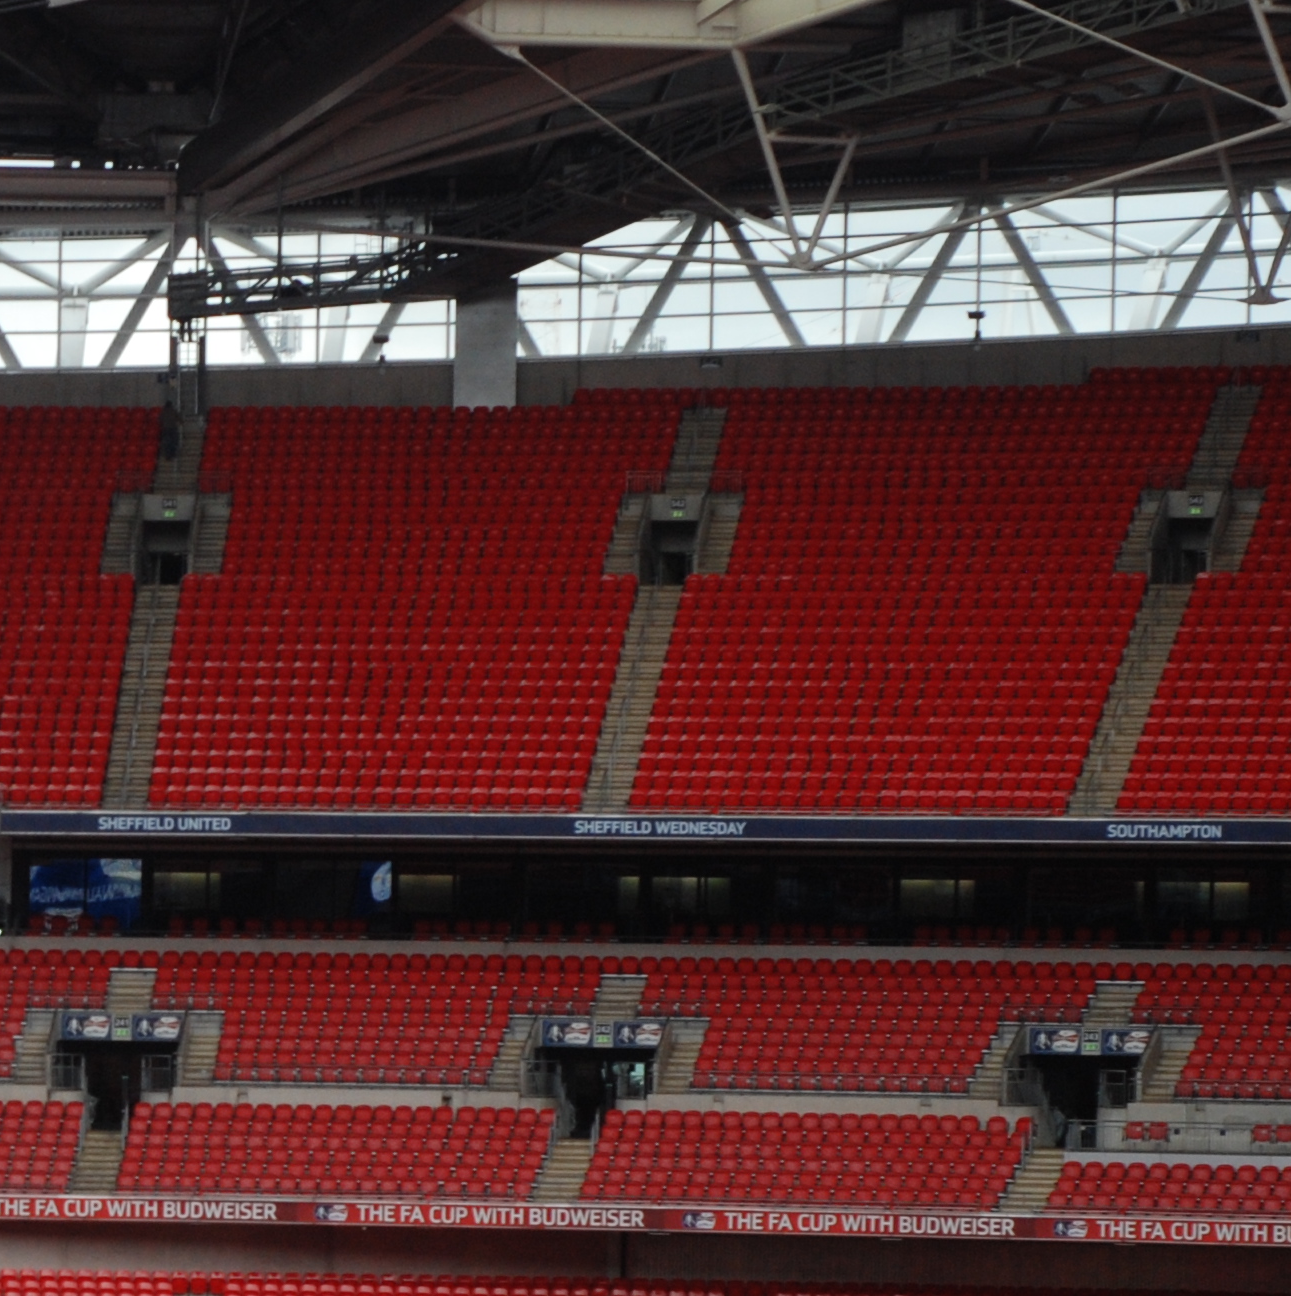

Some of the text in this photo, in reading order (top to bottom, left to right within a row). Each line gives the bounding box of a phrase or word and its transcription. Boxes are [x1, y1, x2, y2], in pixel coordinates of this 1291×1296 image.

[98, 817, 231, 831] SHEFFIELD UNITED
[574, 820, 747, 836] SHEFFIELD WEDNESDAY
[1107, 825, 1222, 839] SOUTHAMPTON
[35, 1198, 59, 1215] FA
[64, 1199, 102, 1216] CUP
[106, 1199, 159, 1216] WITH
[162, 1201, 277, 1219] BUDWEISER
[357, 1204, 644, 1226] THE FA CUP WITH BUDWEISER
[724, 1212, 1015, 1234] THE FA CUP WITH BUDWEISER
[1097, 1221, 1137, 1238] THE
[1142, 1221, 1166, 1238] FA
[1171, 1222, 1211, 1239] CUP
[1215, 1223, 1268, 1240] WITH
